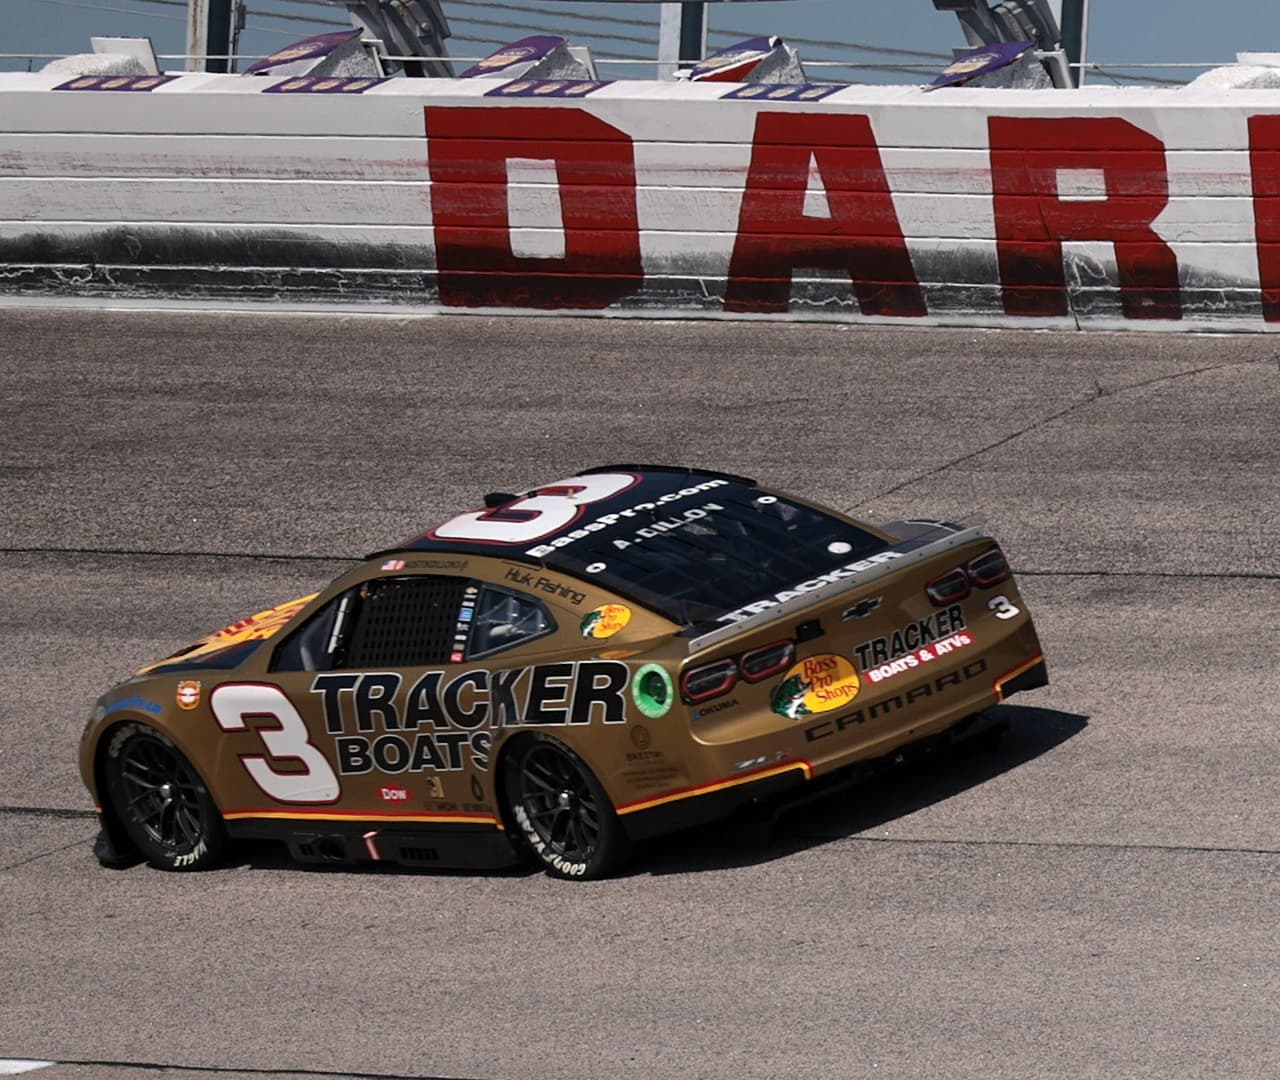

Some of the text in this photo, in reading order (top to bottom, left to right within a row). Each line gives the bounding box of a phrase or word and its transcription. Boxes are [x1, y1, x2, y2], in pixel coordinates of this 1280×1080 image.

[427, 470, 644, 546] 3
[525, 478, 731, 558] BassPro.com
[504, 566, 587, 607] Huk Fishing
[716, 551, 905, 625] TRACKER
[988, 595, 1020, 620] 3
[854, 604, 968, 672] TRACKER
[868, 634, 972, 683] BOATS & ATVs
[311, 660, 630, 734] TRACKER
[803, 656, 838, 680] Bass
[809, 672, 833, 692] Pro
[815, 682, 860, 704] Shops
[804, 658, 989, 742] CAMARO
[210, 680, 343, 803] 3
[335, 731, 494, 775] BOATS
